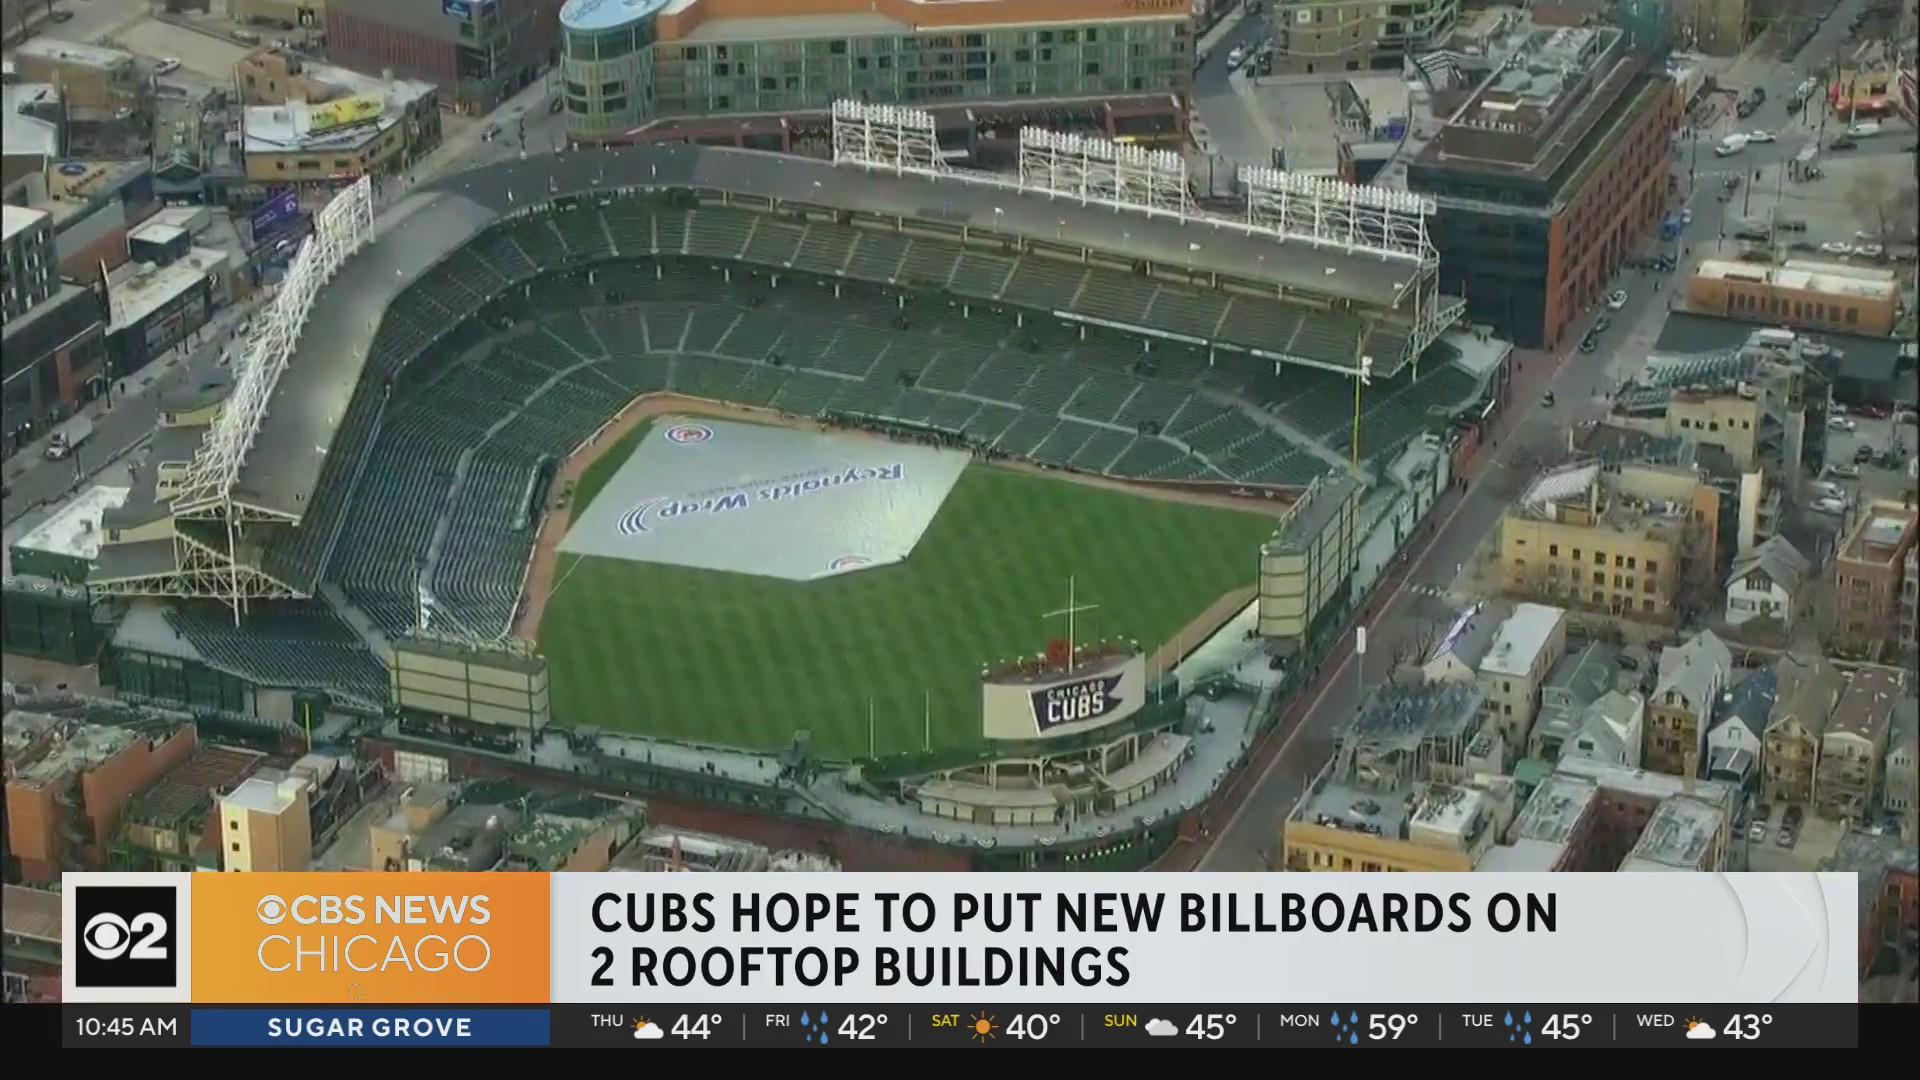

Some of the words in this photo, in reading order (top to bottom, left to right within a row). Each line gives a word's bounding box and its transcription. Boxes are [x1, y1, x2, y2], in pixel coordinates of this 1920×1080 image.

[758, 463, 903, 500] Reynolds
[658, 493, 748, 518] Wrap
[1047, 680, 1104, 700] CHICAGO
[1048, 691, 1104, 722] CUBS
